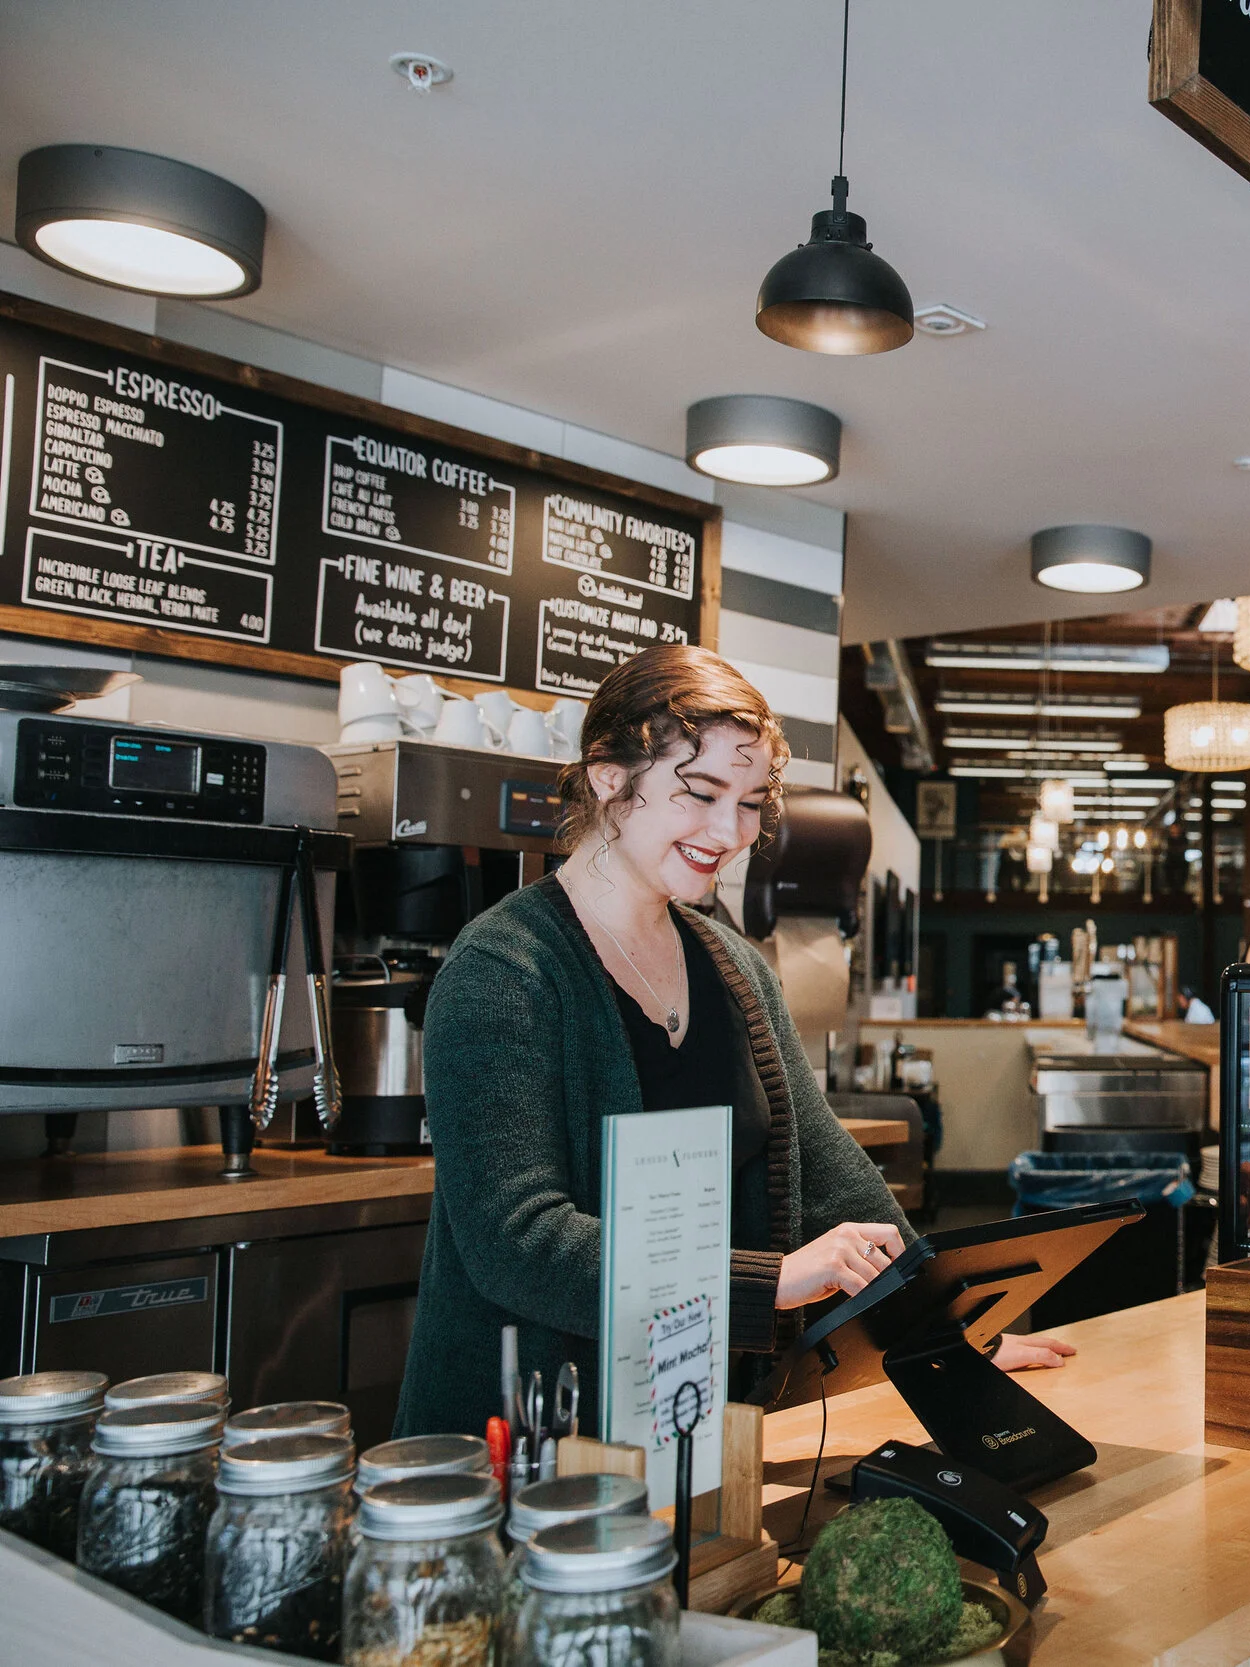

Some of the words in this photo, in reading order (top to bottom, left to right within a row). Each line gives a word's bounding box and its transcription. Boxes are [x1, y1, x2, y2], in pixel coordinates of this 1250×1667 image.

[47, 383, 88, 409] DOPPIO
[94, 396, 145, 424] ESPRESSO
[115, 367, 216, 421] ESPRESSO
[45, 420, 105, 449] GIBRALTAR
[46, 402, 101, 431] ESPRESSO
[105, 418, 165, 448] MACCHIATO
[43, 454, 82, 479] LATTE
[44, 437, 113, 469] CAPPUCCINO
[356, 434, 428, 479] EQUATOR
[432, 457, 488, 497] COFFEE
[42, 473, 83, 498] MOCHA
[355, 468, 388, 491] COFFEE
[40, 493, 106, 523] AMERICANO
[330, 511, 354, 531] COLD
[331, 495, 366, 518] FRENCH
[368, 504, 396, 526] PRESS
[625, 515, 686, 553] FAVORITES
[136, 539, 178, 575] TEA
[38, 556, 101, 585] INCREDIBLE
[103, 570, 138, 592] LOOSE
[139, 577, 166, 596] LEAF
[167, 583, 207, 605] BLENDS
[344, 554, 382, 586] FINE
[385, 562, 425, 596] WINE
[429, 573, 445, 600] &
[449, 578, 486, 610] BEER
[35, 576, 76, 599] GREEN,
[77, 584, 116, 607] BLACK,
[160, 598, 191, 619] YERBA
[192, 605, 220, 624] MATE
[354, 592, 417, 626] Available
[420, 607, 440, 630] all
[442, 611, 472, 640] day!
[554, 597, 611, 628] CUSTOMIZE
[387, 624, 423, 651] don't
